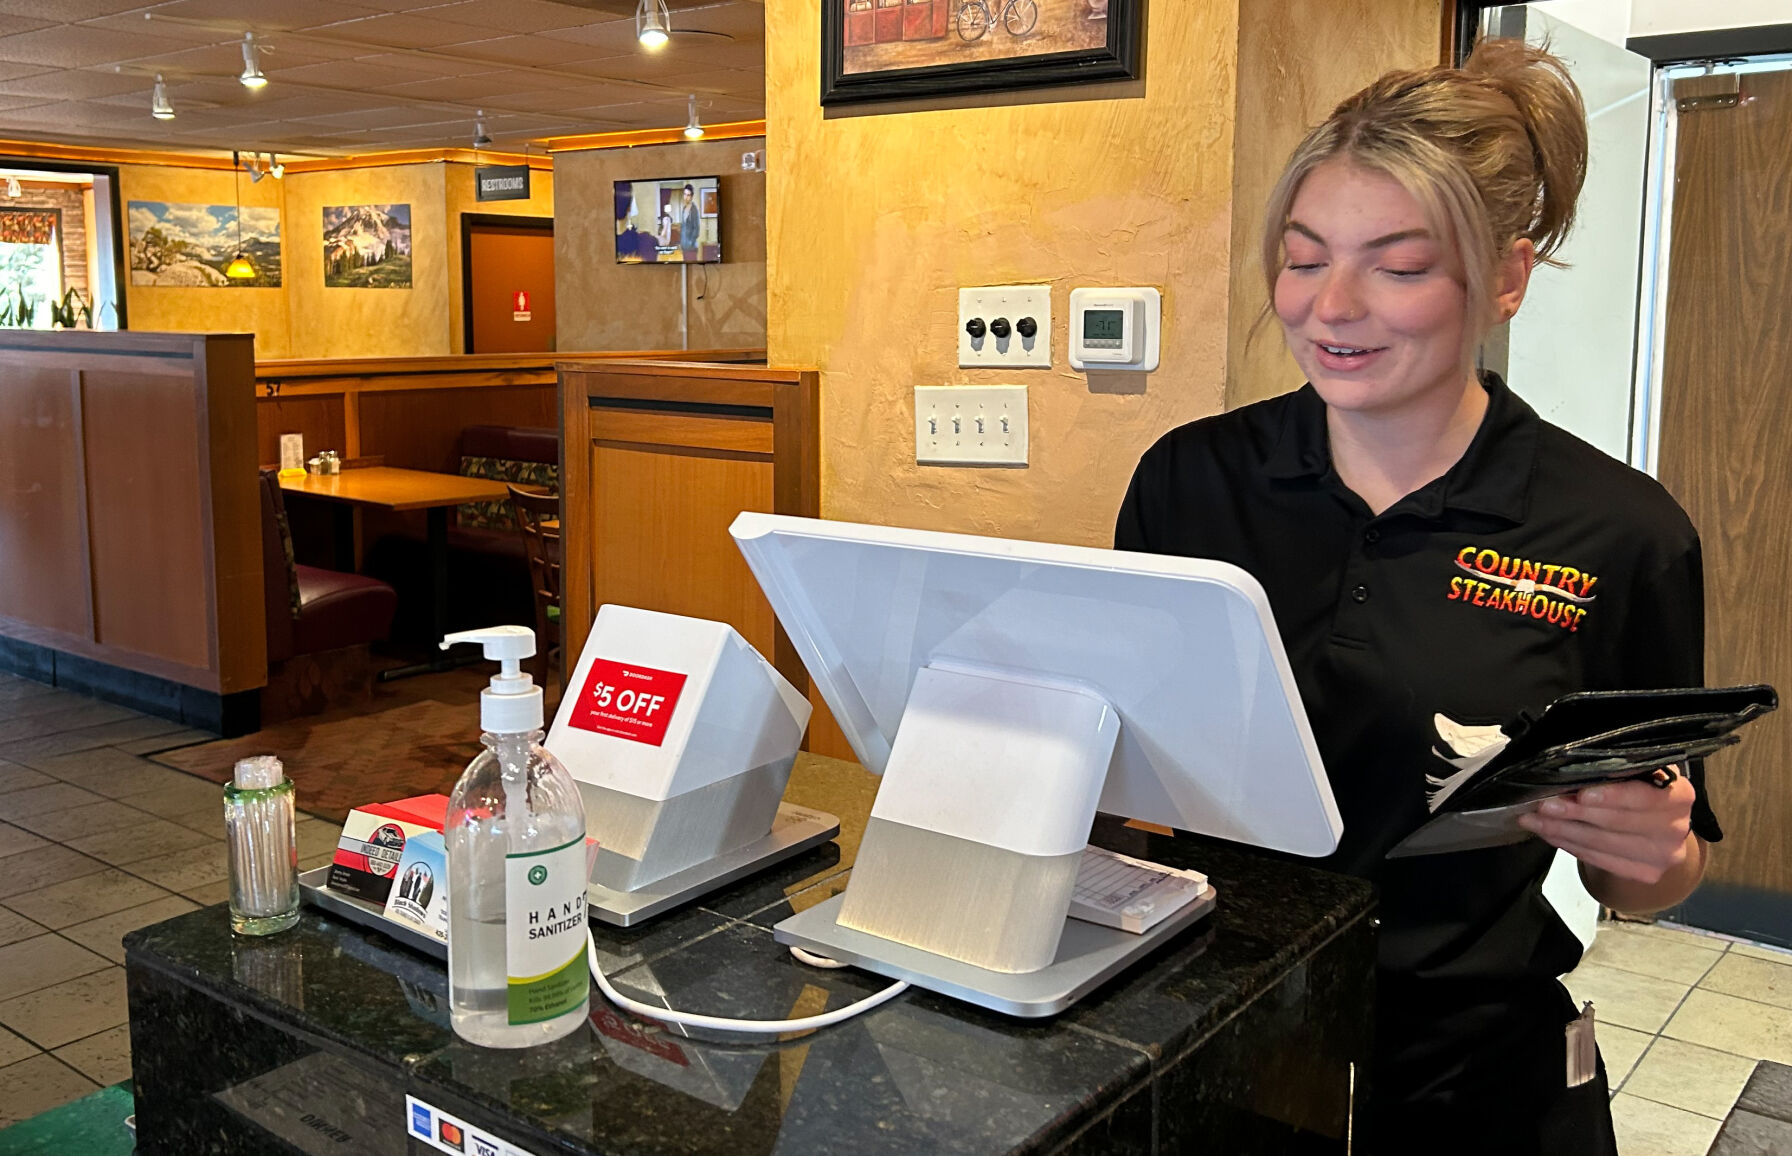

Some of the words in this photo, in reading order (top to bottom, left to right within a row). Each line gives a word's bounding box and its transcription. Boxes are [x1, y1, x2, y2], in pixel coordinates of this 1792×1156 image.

[481, 177, 524, 191] RESTROOMS
[266, 383, 281, 397] 57
[1457, 546, 1598, 597] COUNTRY
[1447, 576, 1587, 632] STEAKHOUSE
[593, 681, 615, 707] $5
[616, 689, 665, 717] OFF
[529, 896, 582, 924] HAND
[529, 913, 582, 940] SANITIZER
[475, 1142, 496, 1156] VISA
